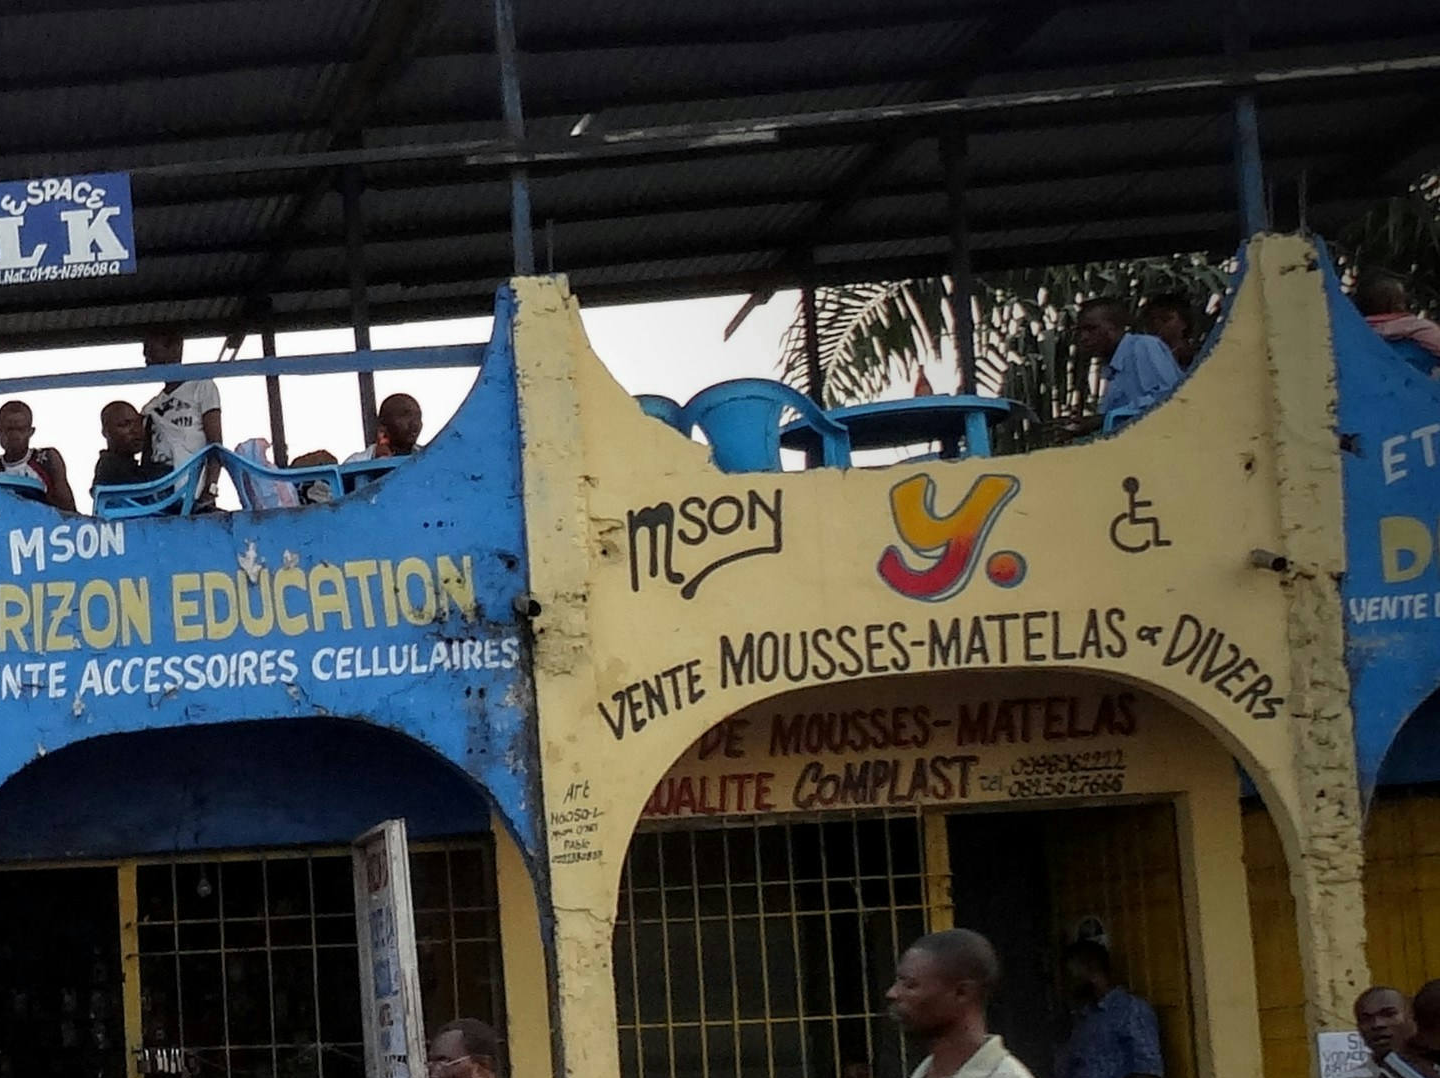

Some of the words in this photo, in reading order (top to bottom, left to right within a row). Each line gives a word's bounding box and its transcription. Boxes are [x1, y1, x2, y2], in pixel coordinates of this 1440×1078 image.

[0, 179, 106, 216] ESPACE
[61, 206, 129, 265] K
[9, 522, 125, 576] MSON
[171, 555, 476, 643] EDUCATION
[1349, 593, 1427, 624] VENTE
[79, 648, 300, 697] ACCESSOIRES
[311, 637, 520, 683] CELLULAIRES
[598, 659, 706, 741] VENTE
[720, 608, 1127, 689] MOUSSES-MATELAS
[1161, 613, 1286, 721] DIVERS
[769, 693, 1137, 758] MOUSSES-MATELAS
